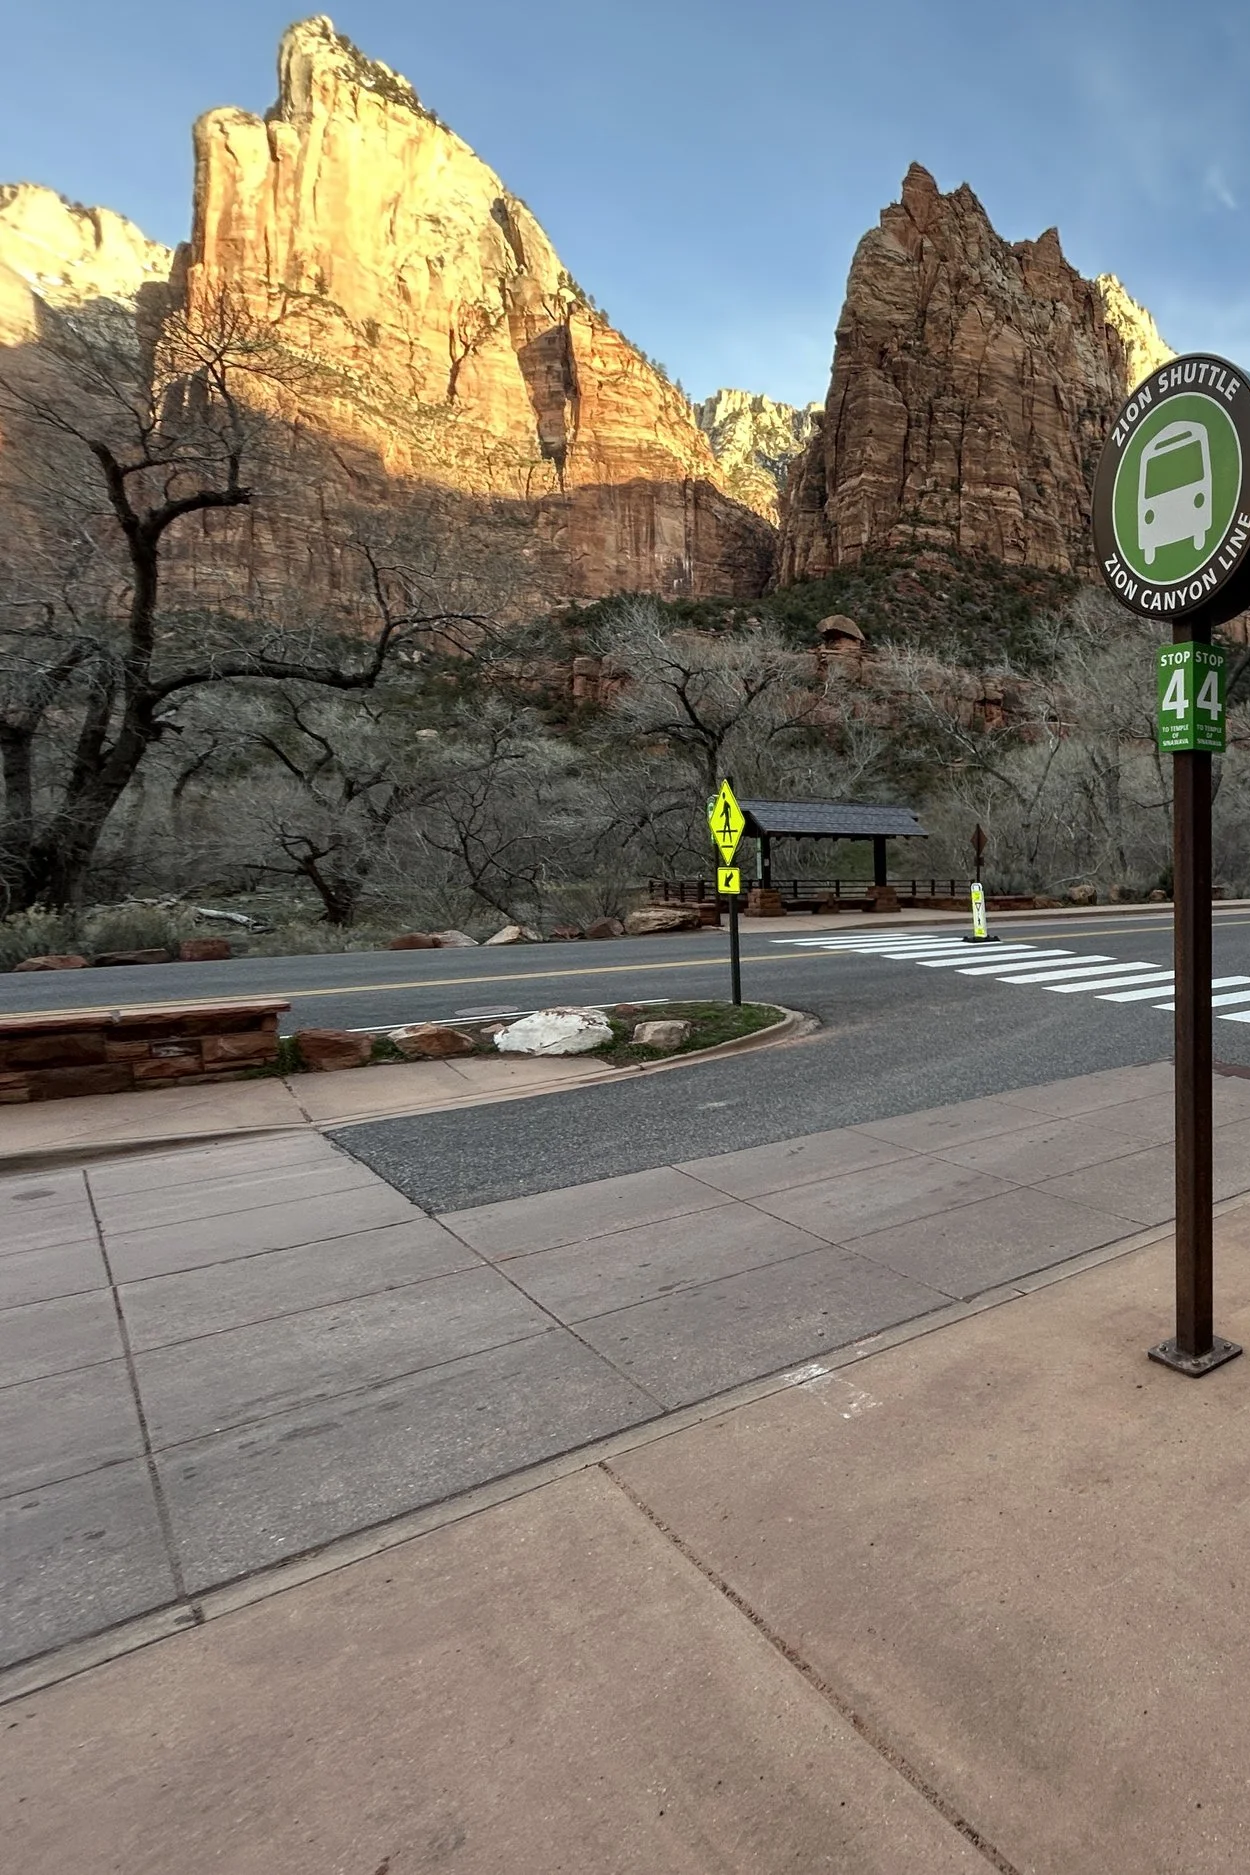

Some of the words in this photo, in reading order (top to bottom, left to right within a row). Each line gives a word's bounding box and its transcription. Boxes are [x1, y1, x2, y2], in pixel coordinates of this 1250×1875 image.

[1112, 386, 1152, 447] ZION
[1158, 362, 1241, 401] SHUTTLE
[1104, 552, 1138, 601] ZION
[1140, 568, 1218, 611] CANYON
[1160, 651, 1190, 667] STOP
[1195, 651, 1223, 667] STOP
[1162, 668, 1189, 719] 4
[1196, 670, 1222, 721] 4
